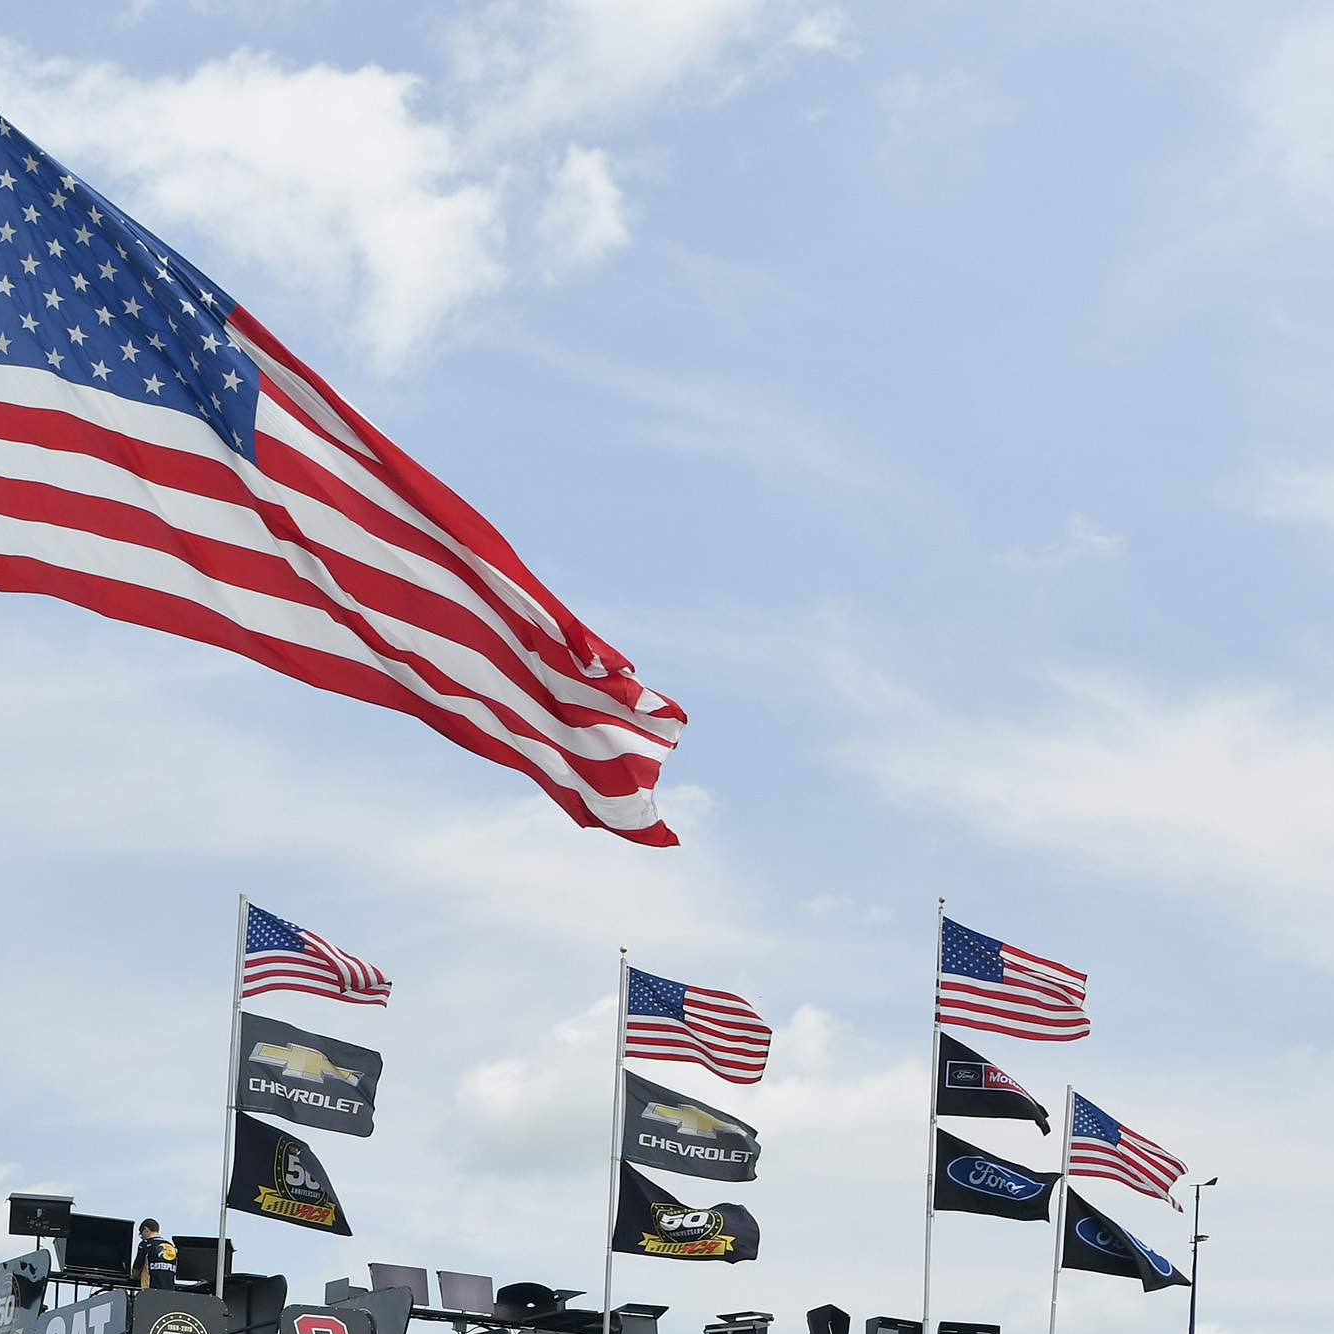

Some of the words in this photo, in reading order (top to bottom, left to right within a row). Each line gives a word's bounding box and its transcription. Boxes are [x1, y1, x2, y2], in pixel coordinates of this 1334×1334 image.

[249, 1077, 364, 1115] CHEVROLET
[638, 1132, 753, 1164] CHEVROLET
[968, 1159, 1027, 1196] Ford
[293, 1203, 332, 1223] RCR
[660, 1210, 710, 1232] 50
[675, 1240, 721, 1255] RCR
